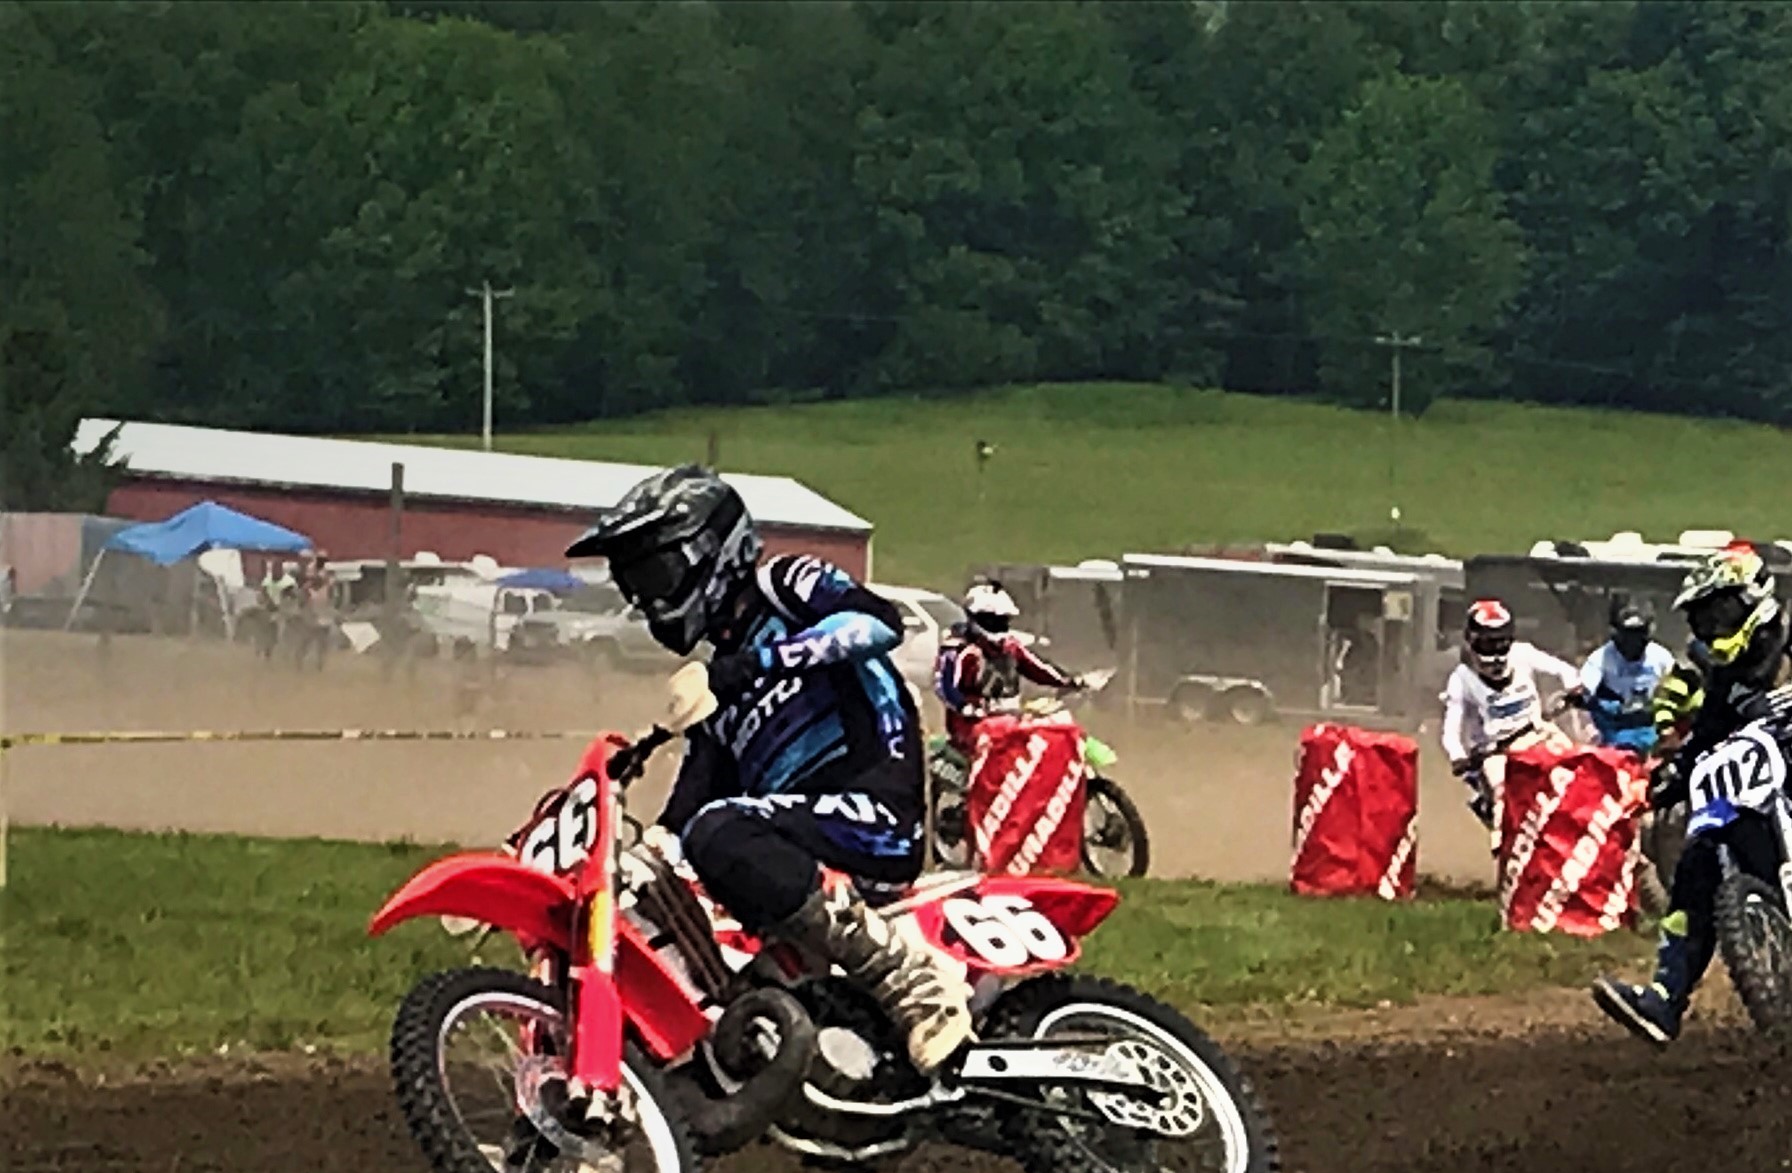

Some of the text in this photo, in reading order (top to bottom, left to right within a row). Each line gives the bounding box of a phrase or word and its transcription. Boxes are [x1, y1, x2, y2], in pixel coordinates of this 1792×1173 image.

[1696, 747, 1774, 806] 102
[521, 777, 598, 874] 66
[942, 895, 1067, 967] 66
